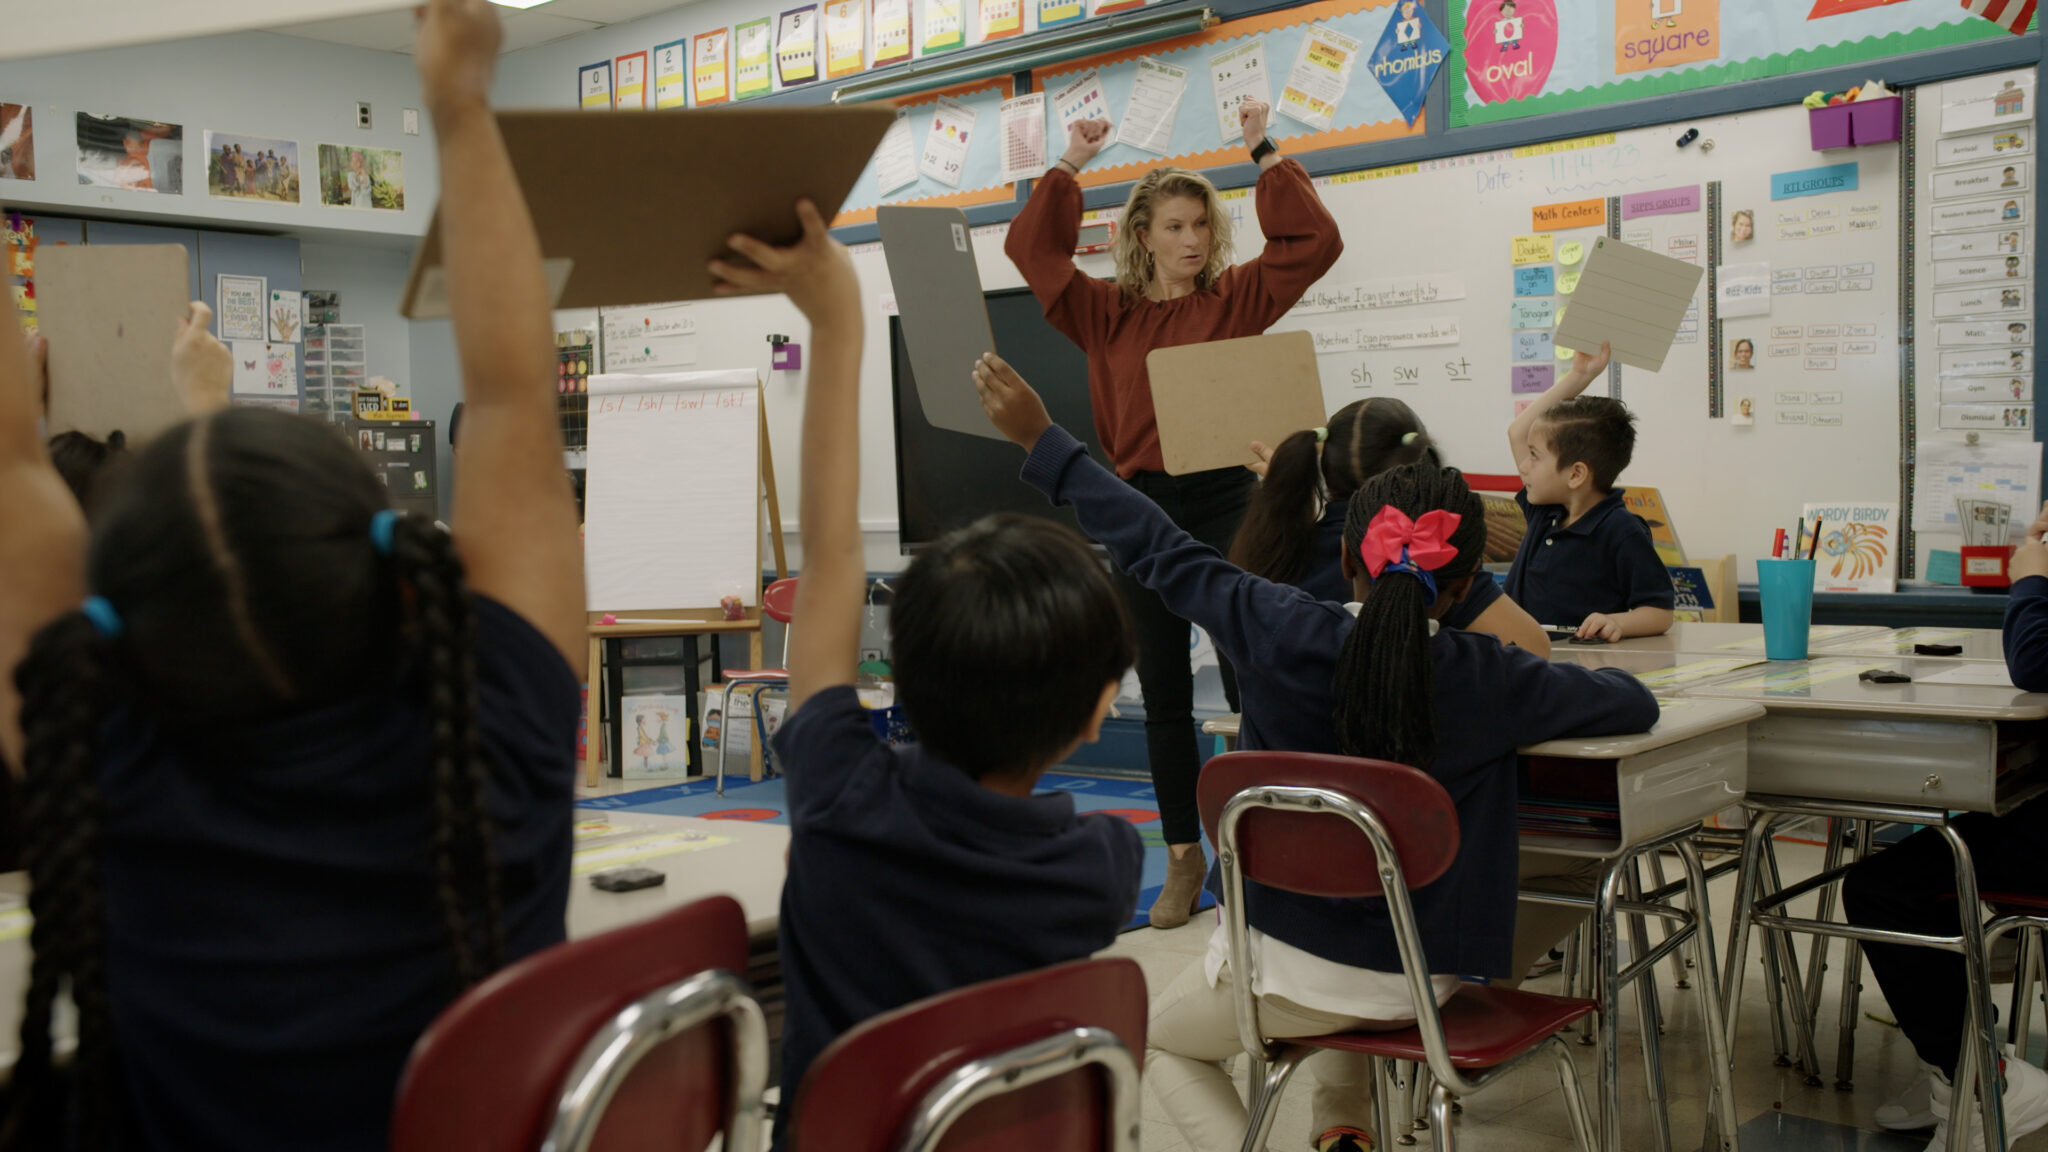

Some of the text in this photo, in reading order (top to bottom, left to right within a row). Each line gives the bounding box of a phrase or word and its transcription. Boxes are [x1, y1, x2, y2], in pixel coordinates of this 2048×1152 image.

[840, 5, 848, 18] 6
[794, 15, 800, 28] 5
[706, 39, 713, 52] 3
[1624, 29, 1710, 62] square
[665, 51, 672, 63] 2
[1375, 48, 1442, 78] rhombus
[627, 61, 632, 72] 1
[1486, 52, 1532, 83] oval
[592, 71, 599, 83] 0
[1800, 176, 1844, 190] GROUPS
[1954, 176, 1989, 186] Breakfast
[1656, 197, 1690, 210] GROUPS
[1534, 205, 1600, 220] Math Centers
[1959, 267, 1986, 275] Science
[1355, 288, 1362, 302] I
[1362, 292, 1376, 301] can
[1428, 282, 1438, 297] by
[1355, 329, 1362, 344] I
[1363, 334, 1378, 343] can
[1416, 324, 1439, 338] words
[1442, 324, 1458, 335] with
[1350, 356, 1471, 384] sh sw st
[637, 394, 664, 412] /sh/
[675, 392, 705, 412] /sw/
[716, 392, 744, 408] /st/
[1961, 414, 1995, 422] Dismissal
[1807, 507, 1850, 521] WORDY
